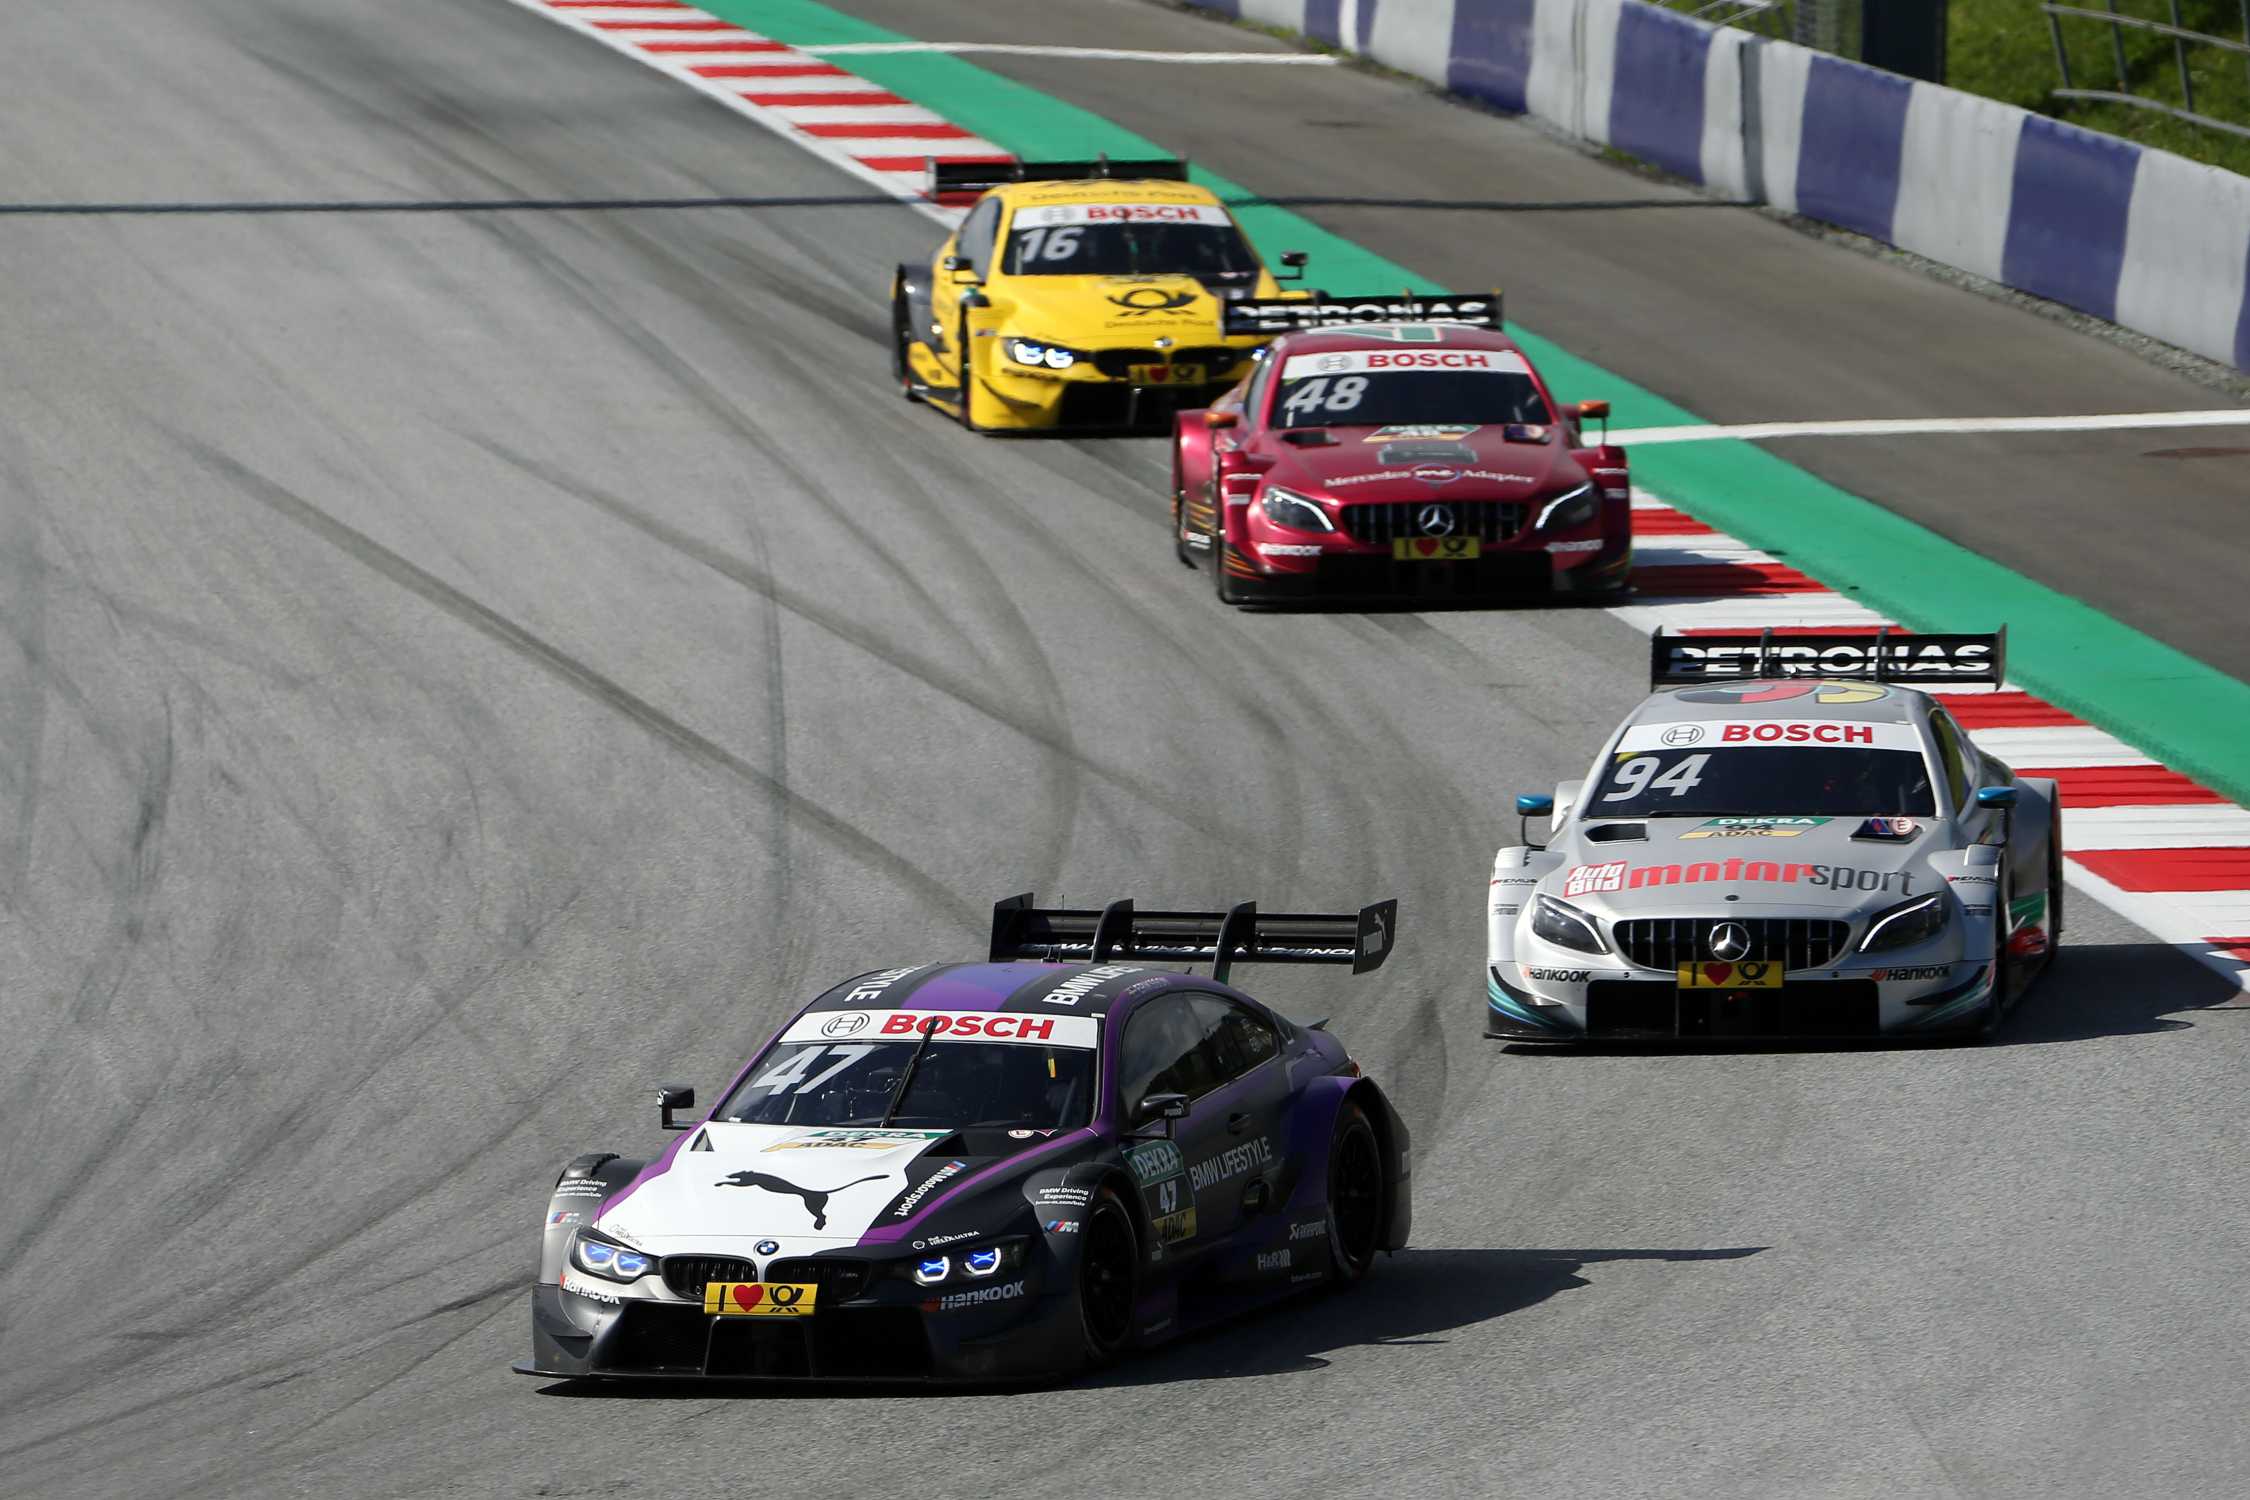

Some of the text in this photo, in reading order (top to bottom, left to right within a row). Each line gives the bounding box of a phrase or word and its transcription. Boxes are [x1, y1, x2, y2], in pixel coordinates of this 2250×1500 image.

[1087, 206, 1200, 220] BOSCH
[1020, 226, 1085, 262] 16
[1367, 353, 1489, 369] BOSCH
[1283, 375, 1370, 414] 48
[1324, 470, 1412, 487] Mercedes
[1461, 469, 1536, 483] Adapter
[1670, 644, 1993, 673] PETRONAS
[1721, 724, 1873, 744] BOSCH
[1602, 753, 1712, 802] 94
[1708, 829, 1773, 839] ADAC
[1566, 863, 1626, 883] Auto
[1567, 876, 1621, 895] Bild
[880, 1014, 1055, 1040] BOSCH
[752, 1045, 877, 1096] 47
[824, 1130, 928, 1139] DEKRA
[795, 1141, 869, 1149] ADAC
[1133, 1141, 1179, 1179] DEKRA
[1190, 1135, 1273, 1192] BMW LIFESTYLE
[580, 1179, 608, 1187] Driving
[1040, 1187, 1089, 1196] BMW Driving
[894, 1172, 947, 1217] Motorsport
[1044, 1193, 1087, 1201] Experience
[1159, 1179, 1177, 1214] 47
[954, 1230, 980, 1240] ULTRA
